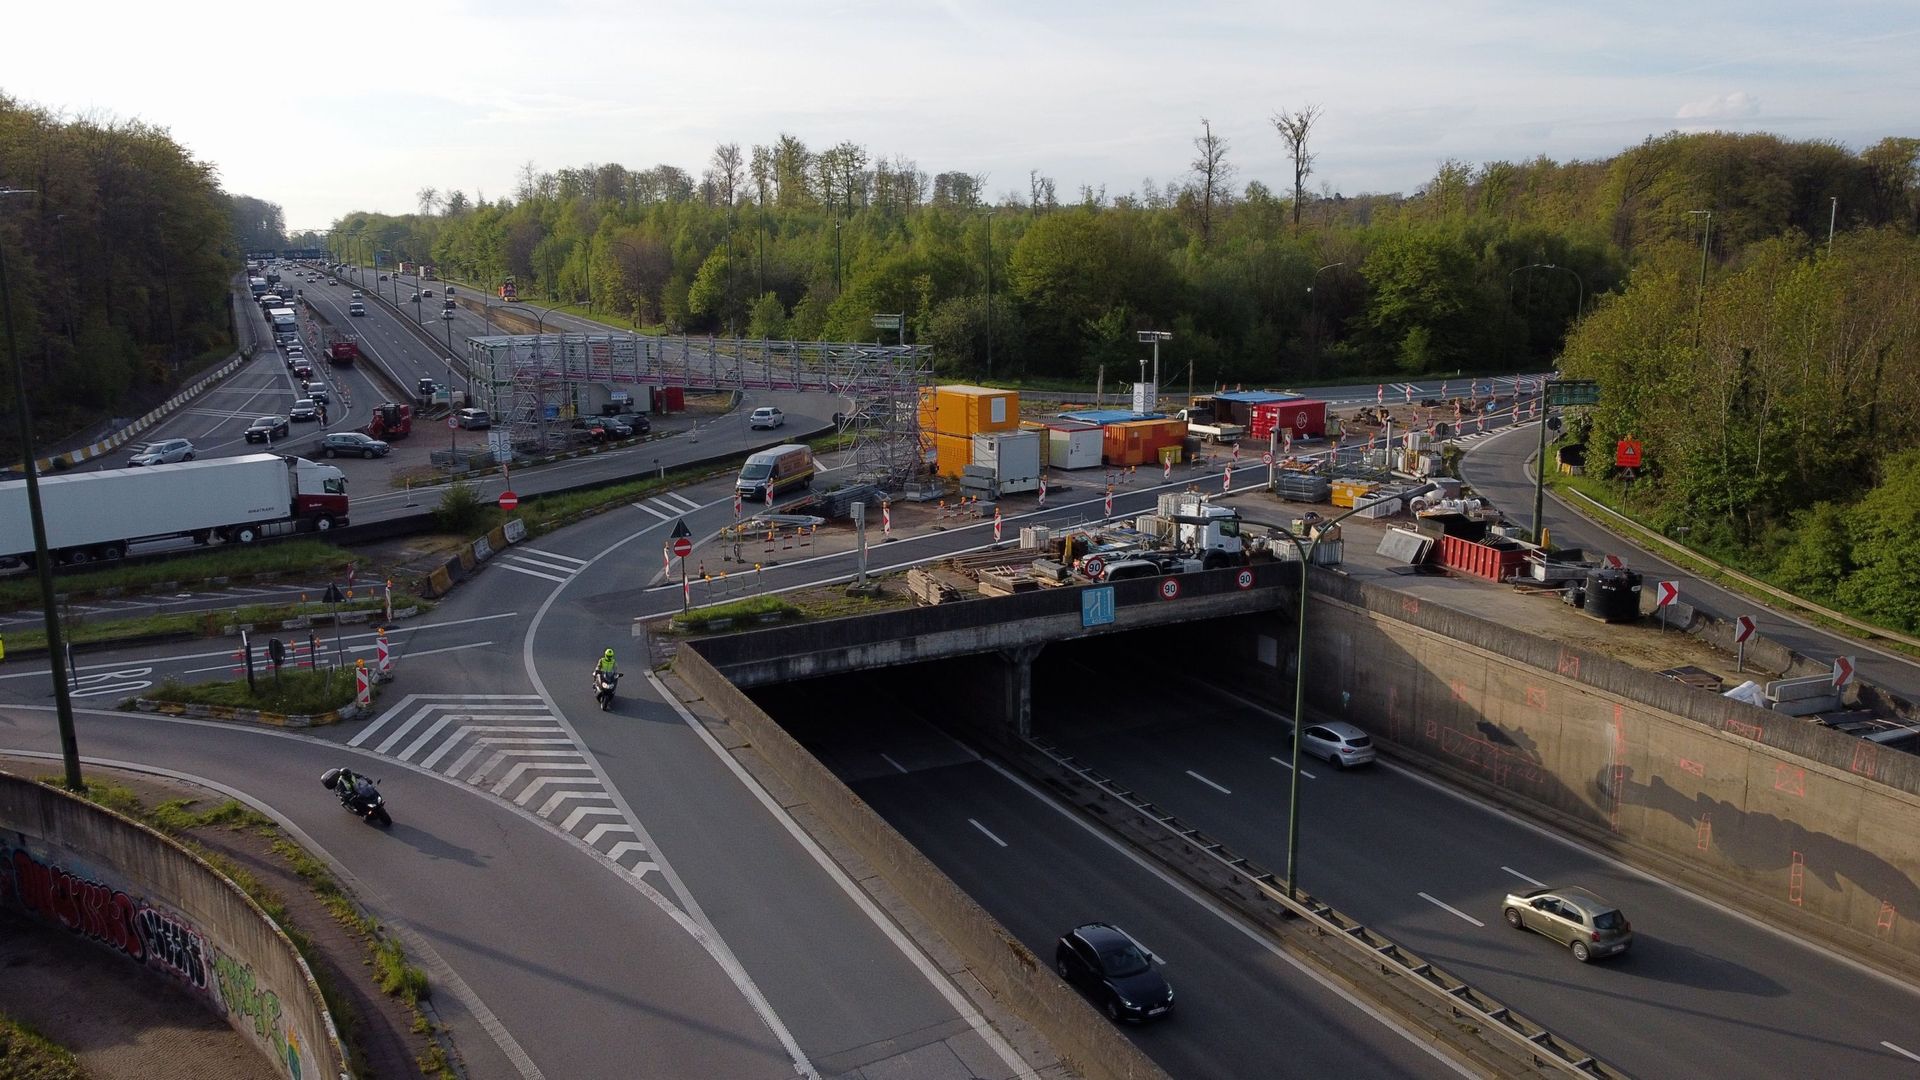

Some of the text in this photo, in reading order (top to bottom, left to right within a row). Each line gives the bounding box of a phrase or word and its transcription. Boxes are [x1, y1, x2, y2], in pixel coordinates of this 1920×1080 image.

[1089, 563, 1100, 572] 90
[1239, 575, 1251, 584] 90
[1165, 584, 1176, 593] 90
